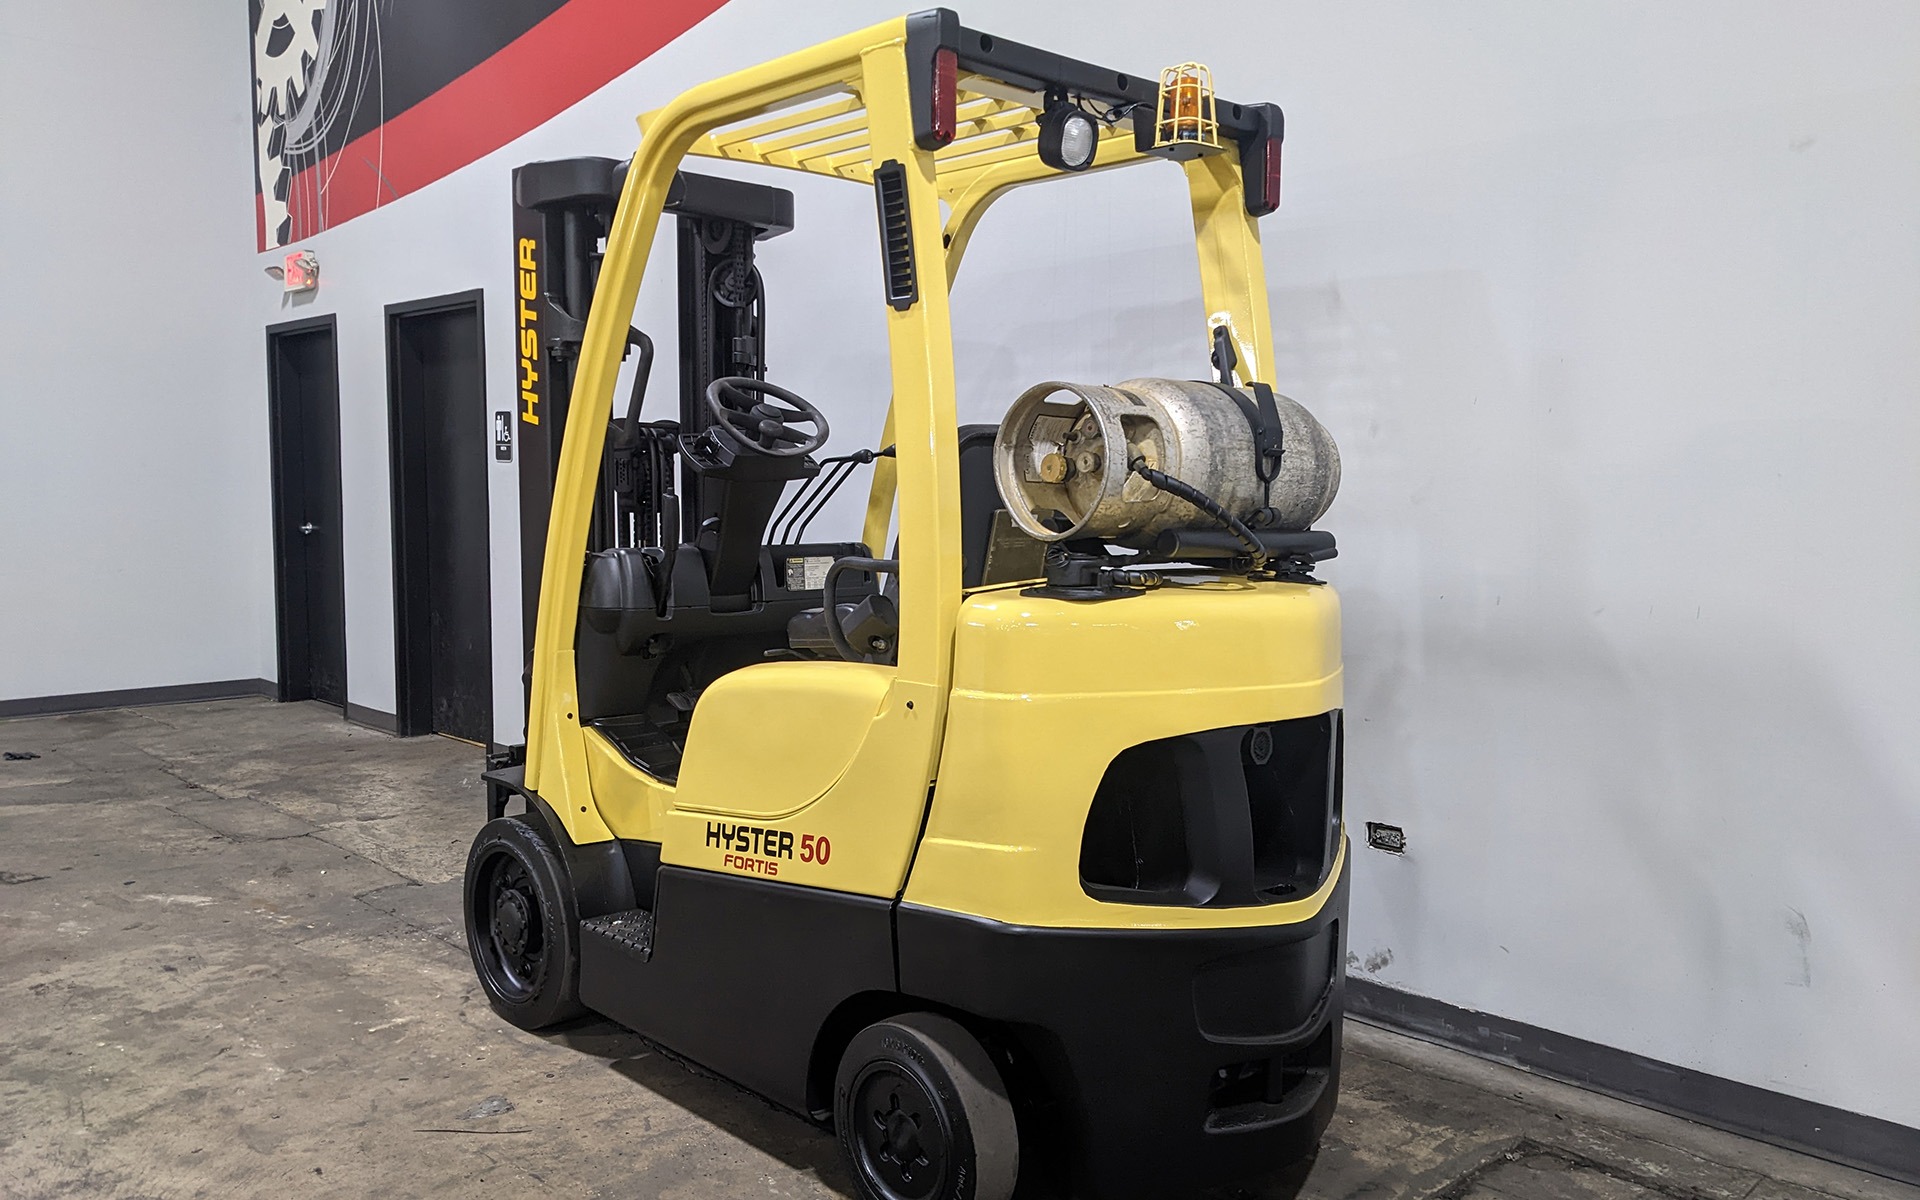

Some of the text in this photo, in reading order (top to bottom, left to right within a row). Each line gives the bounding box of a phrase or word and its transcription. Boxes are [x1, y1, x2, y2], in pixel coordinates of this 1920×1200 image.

[519, 237, 539, 426] HYSTER
[706, 821, 831, 865] HYSTER 50
[724, 854, 779, 876] FORTIS
